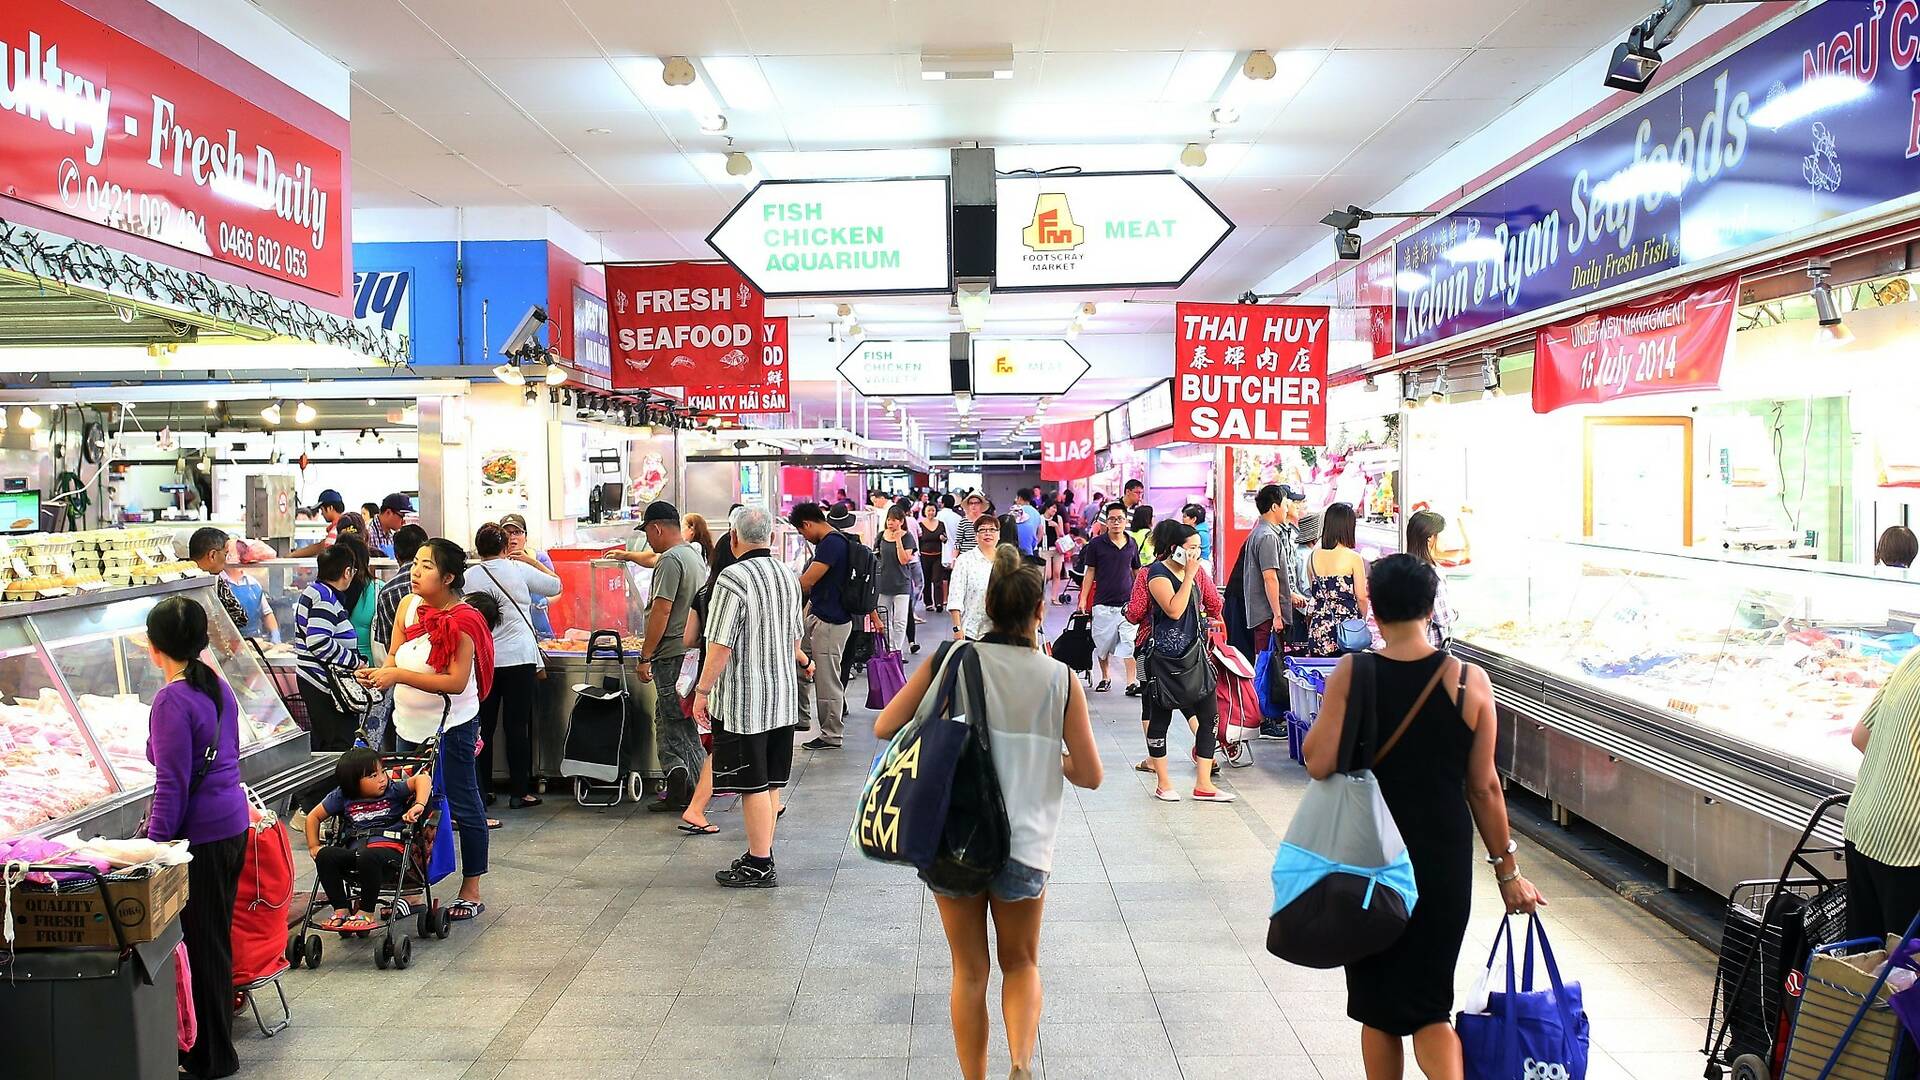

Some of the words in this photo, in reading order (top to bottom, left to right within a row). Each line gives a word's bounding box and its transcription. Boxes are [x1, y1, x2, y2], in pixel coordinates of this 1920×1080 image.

[147, 94, 245, 194] Fresh
[256, 144, 327, 250] Daily
[1489, 209, 1560, 306] Ryan
[1569, 69, 1750, 254] Seafoods
[763, 203, 823, 221] FISH
[86, 175, 133, 225] 0421
[219, 221, 253, 262] 0466
[257, 235, 281, 271] 602
[285, 244, 307, 278] 053
[763, 226, 884, 247] CHICKEN
[1105, 220, 1177, 239] MEAT
[766, 250, 900, 272] AQUARIUM
[1022, 253, 1084, 262] FOOTSCRAY
[1032, 262, 1076, 271] MARKET
[1571, 258, 1602, 290] Daily
[1604, 246, 1638, 280] Fresh
[1641, 233, 1669, 267] Fish
[636, 288, 732, 314] FRESH
[1183, 315, 1248, 341] THAI
[1262, 317, 1325, 343] HUY
[1570, 318, 1601, 348] UNDER
[1601, 314, 1623, 340] NEW
[1624, 301, 1688, 336] MANAGMENT
[619, 324, 752, 351] SEAFOOD
[864, 351, 893, 360] FISH
[1581, 351, 1595, 390] 15
[1593, 345, 1633, 394] July
[1635, 336, 1678, 382] 2014
[864, 363, 922, 371] CHICKEN
[1182, 373, 1320, 405] BUTCHER
[687, 395, 716, 411] KHAI
[719, 395, 736, 410] KY
[1190, 406, 1310, 441] SALE
[26, 901, 94, 913] QUALITY
[33, 915, 85, 927] FRESH
[36, 931, 84, 943] FRUIT
